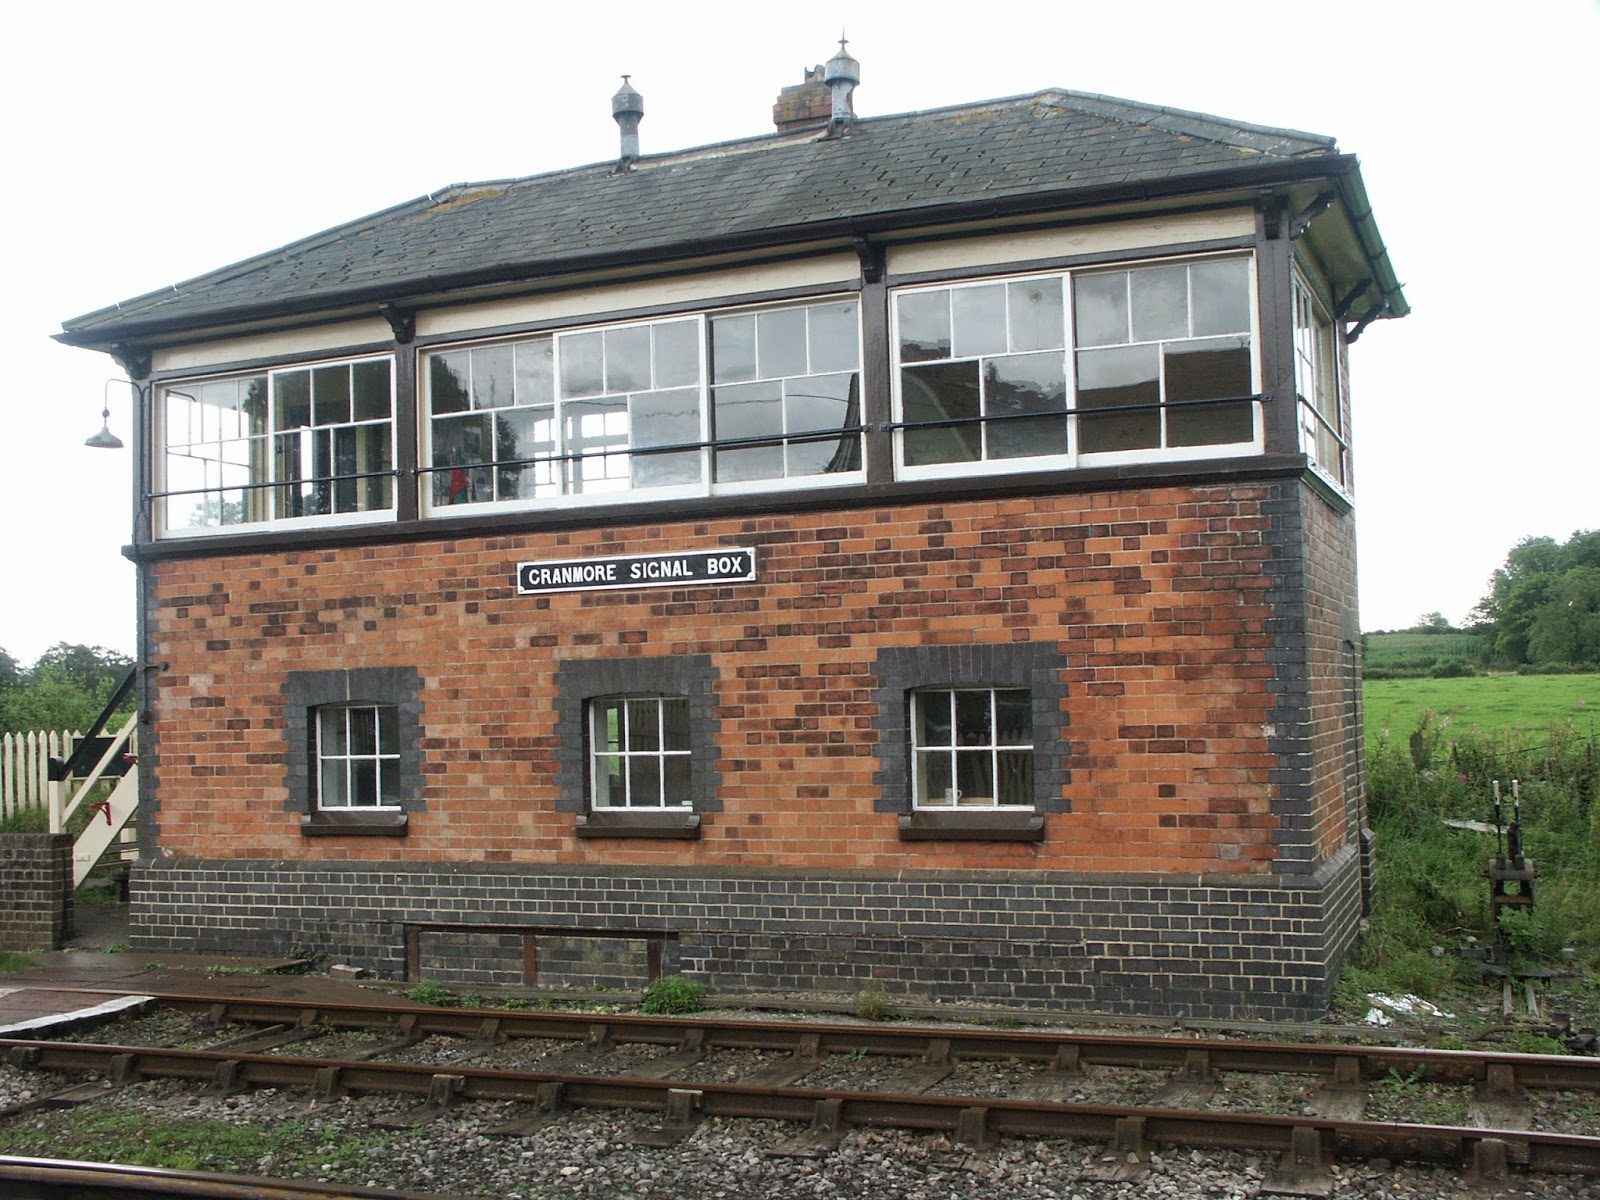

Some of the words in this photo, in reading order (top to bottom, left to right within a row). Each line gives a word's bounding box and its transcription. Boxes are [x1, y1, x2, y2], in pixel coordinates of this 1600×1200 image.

[528, 564, 617, 585] CRANMORE
[630, 559, 693, 579] SIGNAL
[707, 556, 742, 575] BOX
